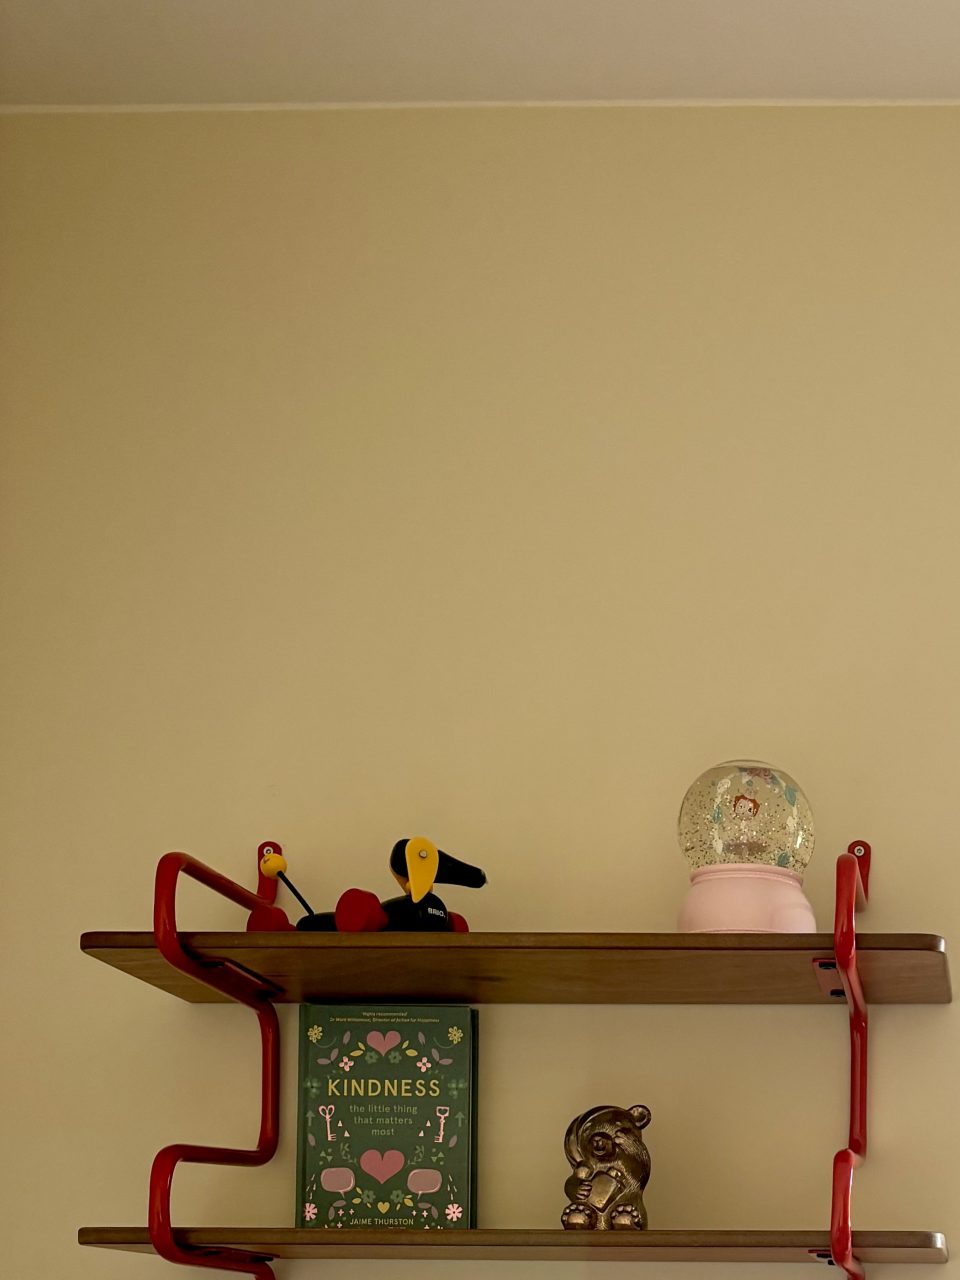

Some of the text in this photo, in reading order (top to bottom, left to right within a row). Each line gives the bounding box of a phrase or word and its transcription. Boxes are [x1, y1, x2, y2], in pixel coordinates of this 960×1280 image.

[327, 1079, 441, 1097] KINDNESS
[349, 1104, 418, 1115] the little thing
[353, 1116, 413, 1125] that matters
[371, 1128, 395, 1136] most
[374, 1218, 414, 1226] THURSTON
